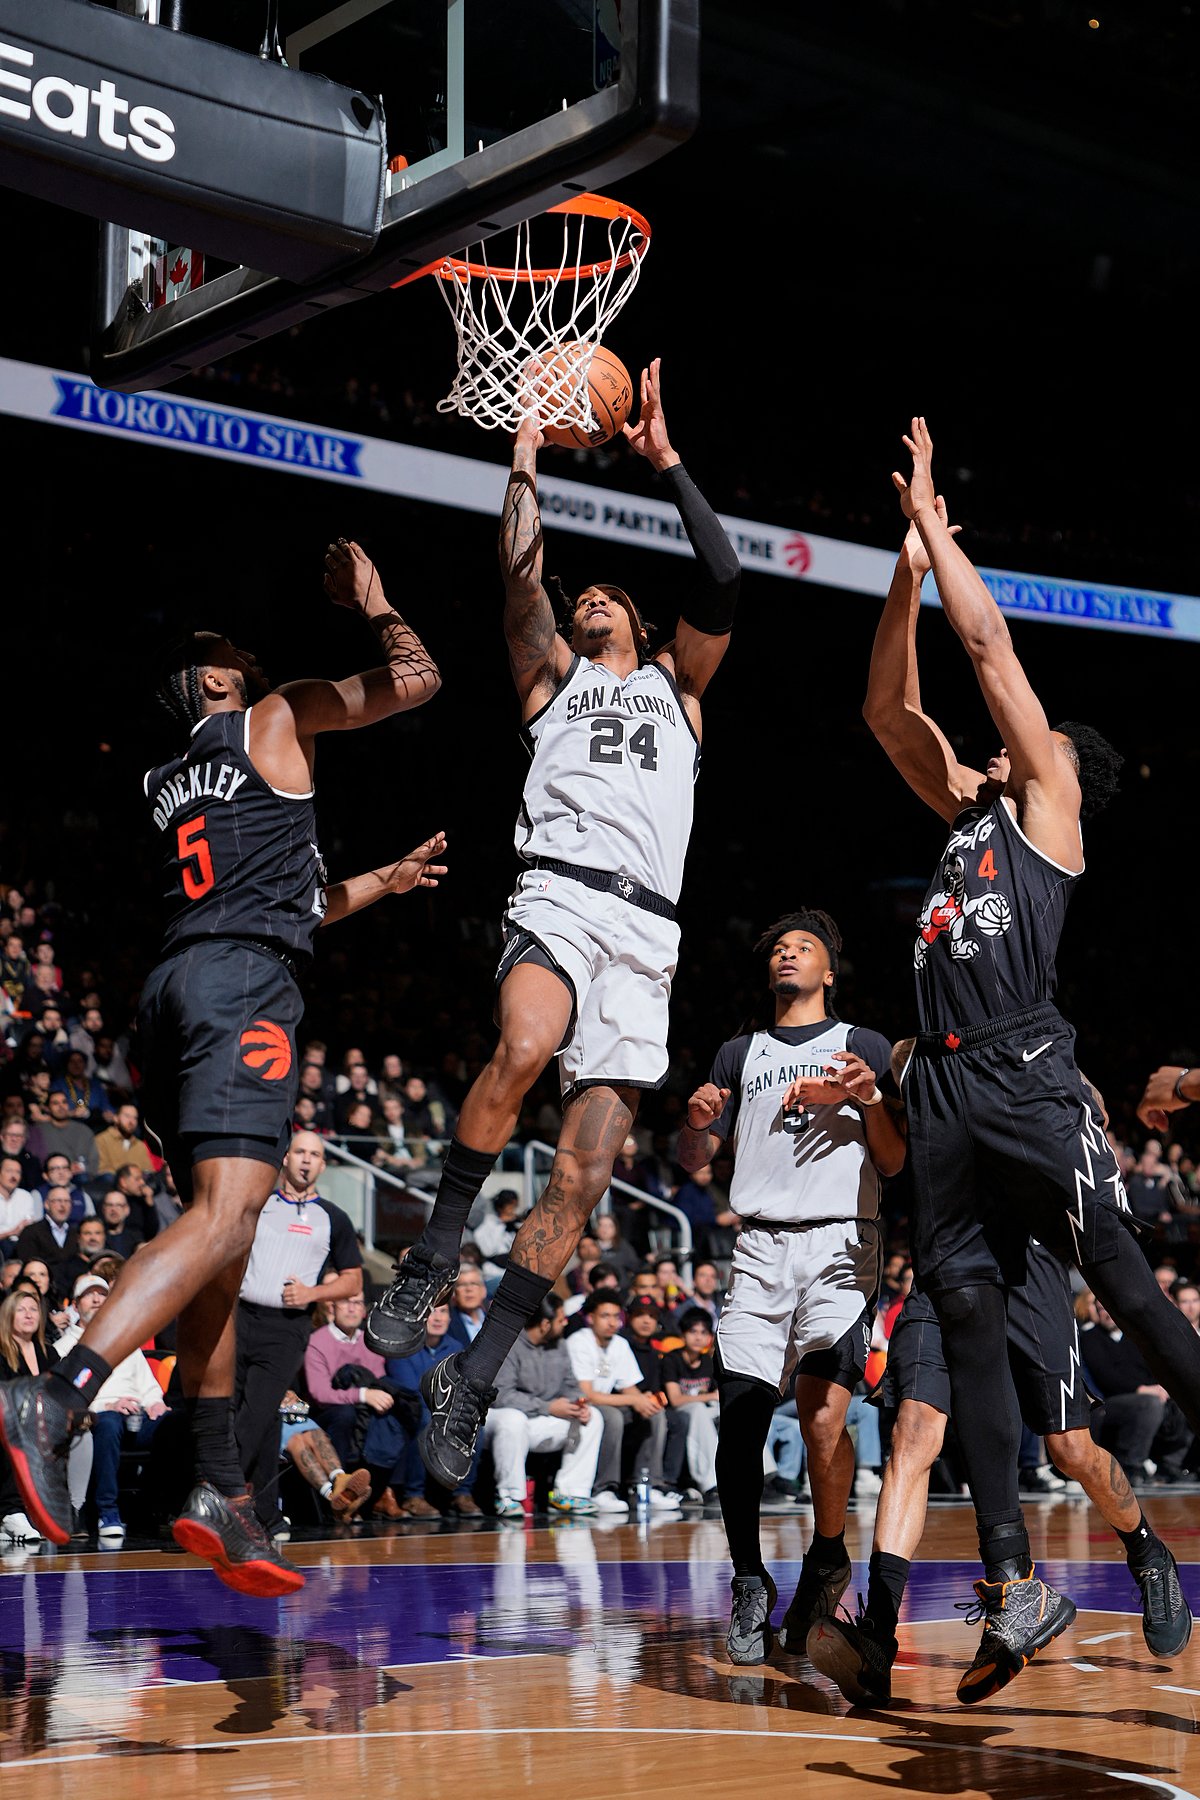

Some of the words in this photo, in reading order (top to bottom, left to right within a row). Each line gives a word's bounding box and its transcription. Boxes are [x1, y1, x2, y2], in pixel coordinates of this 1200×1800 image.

[0, 42, 176, 162] Eats
[73, 384, 249, 450] TORONTO
[256, 423, 347, 470] STAR
[537, 489, 597, 521] ROUD
[603, 504, 690, 541] PARTNE
[737, 534, 775, 560] THE
[985, 575, 1086, 617] RONTO
[1092, 592, 1164, 624] STAR
[566, 685, 605, 721] SAN
[609, 686, 677, 728] ATONIO
[589, 718, 658, 772] 24
[176, 814, 216, 900] 5
[977, 848, 999, 881] 4
[746, 1069, 774, 1103] SAN
